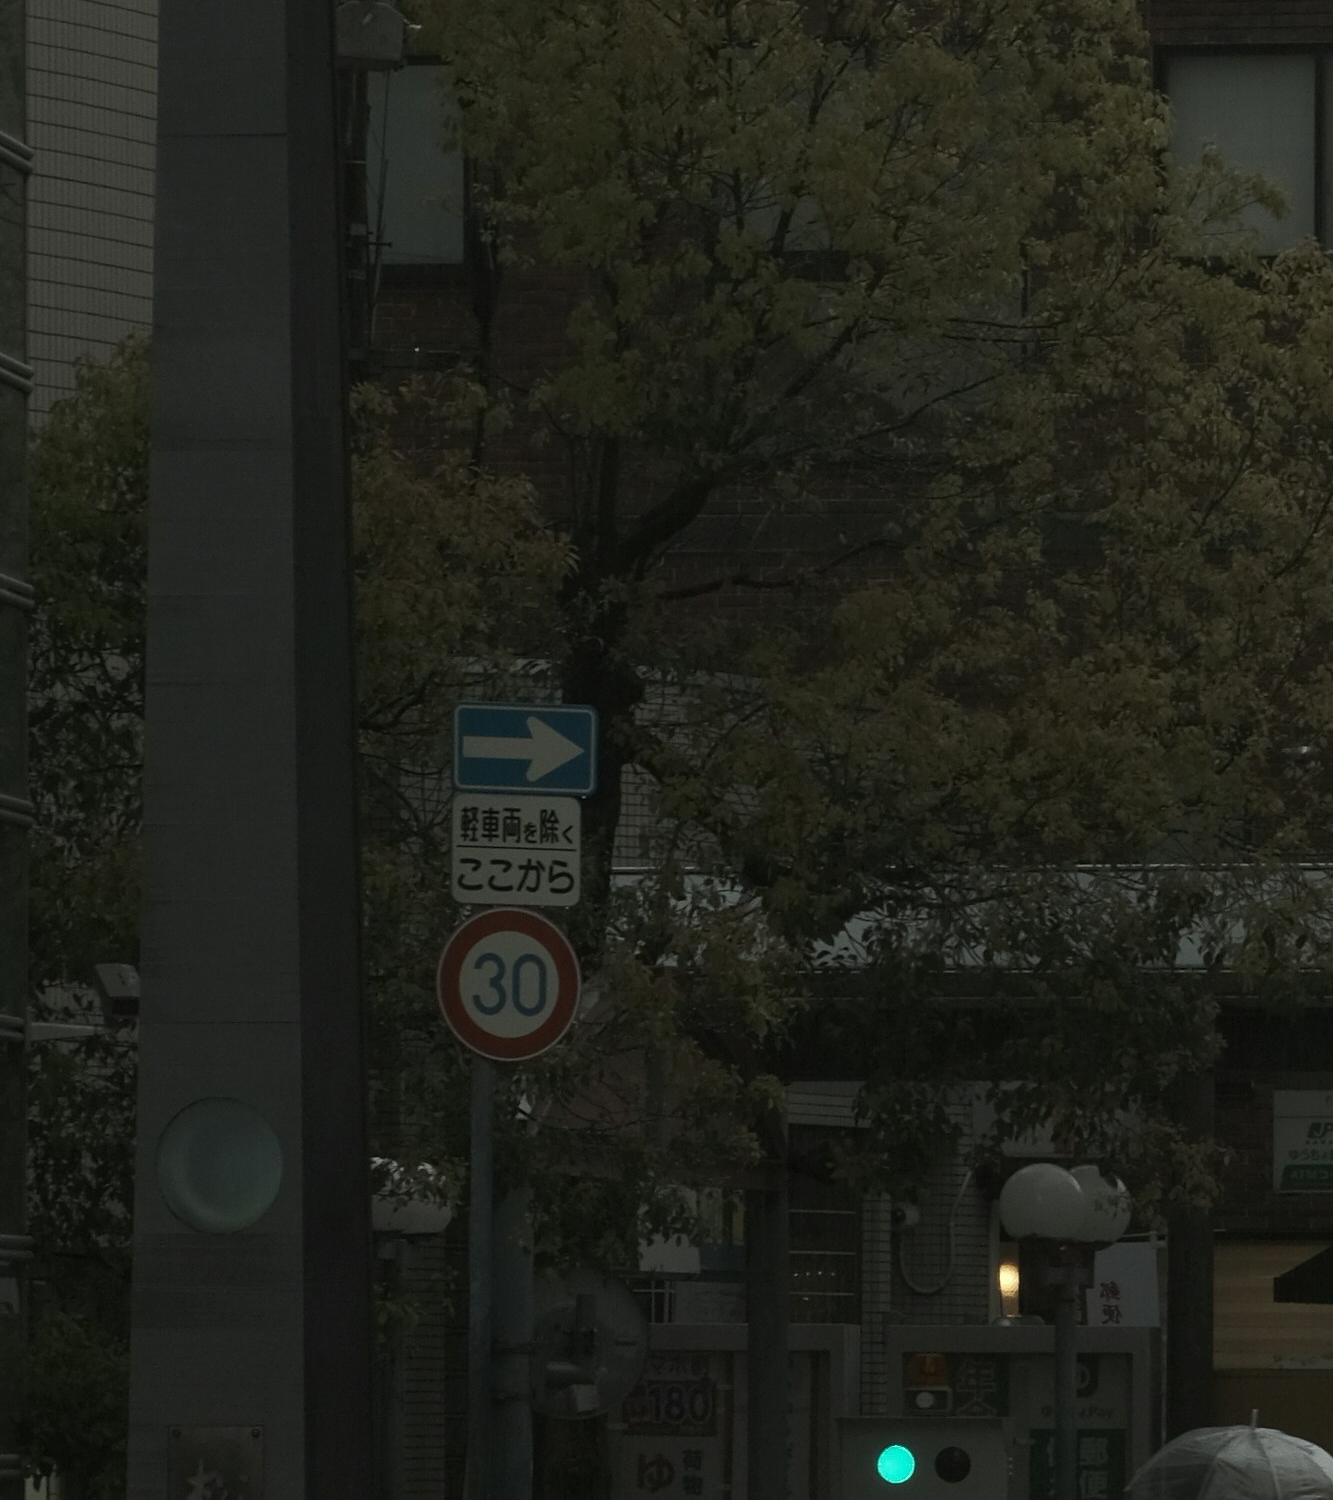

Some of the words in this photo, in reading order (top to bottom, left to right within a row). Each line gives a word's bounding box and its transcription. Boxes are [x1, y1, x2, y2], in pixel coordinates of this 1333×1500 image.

[461, 807, 575, 845] 軽車両を除く
[457, 857, 575, 894] ここから
[473, 952, 548, 1017] 30
